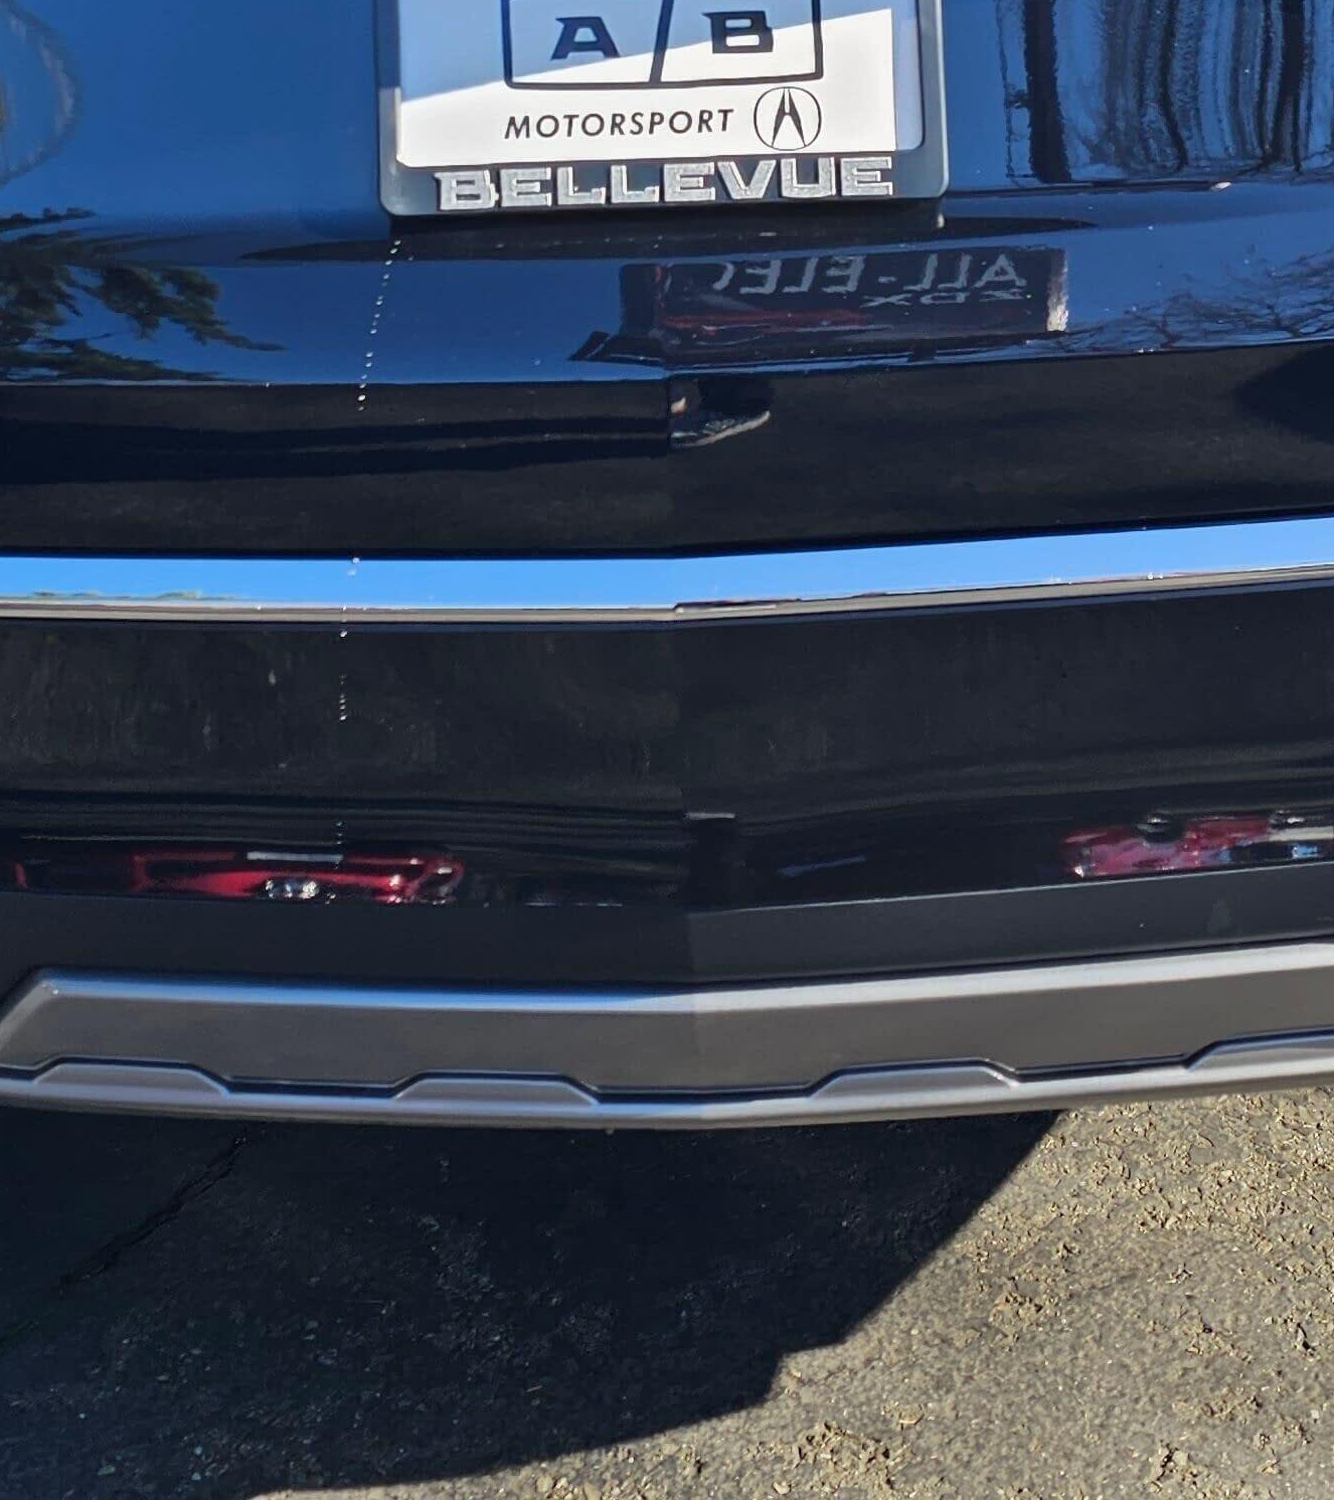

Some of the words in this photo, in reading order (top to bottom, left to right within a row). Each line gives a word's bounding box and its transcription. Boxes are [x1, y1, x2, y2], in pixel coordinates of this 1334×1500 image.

[550, 15, 622, 61] A
[702, 10, 775, 54] B
[504, 107, 735, 140] MOTORSPORT
[432, 155, 894, 212] BELLEVUE
